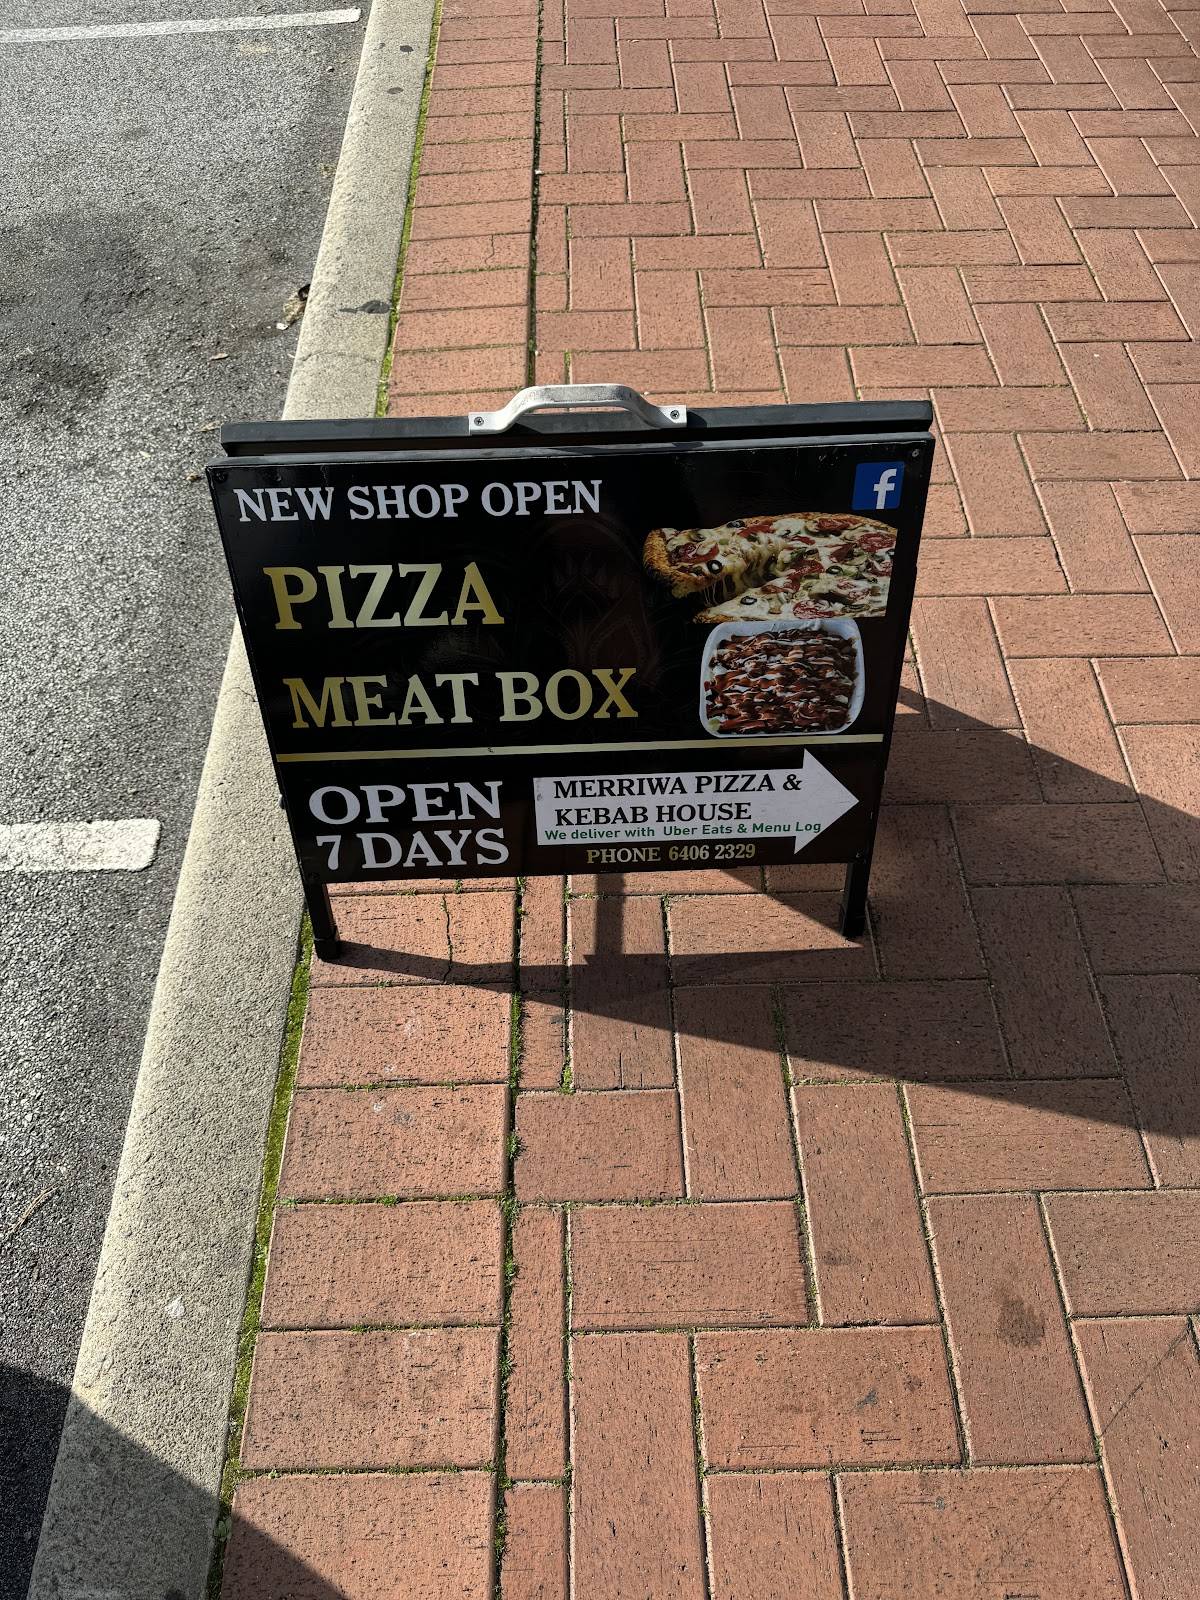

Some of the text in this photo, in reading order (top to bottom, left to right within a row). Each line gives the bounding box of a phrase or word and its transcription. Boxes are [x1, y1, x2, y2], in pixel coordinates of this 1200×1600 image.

[234, 479, 602, 522] NEW SHOP OPEN
[873, 468, 897, 509] f
[263, 561, 504, 630] PIZZA
[283, 668, 638, 728] MEAT BOX
[309, 780, 504, 824] OPEN
[554, 774, 802, 798] MERRIWA PIZZA &
[545, 822, 821, 840] We deliver with Uber Eats & Menu Log
[555, 802, 751, 826] KEBAB HOUSE
[316, 828, 509, 871] 7 DAYS
[587, 844, 755, 863] PHONE 6406 2329
